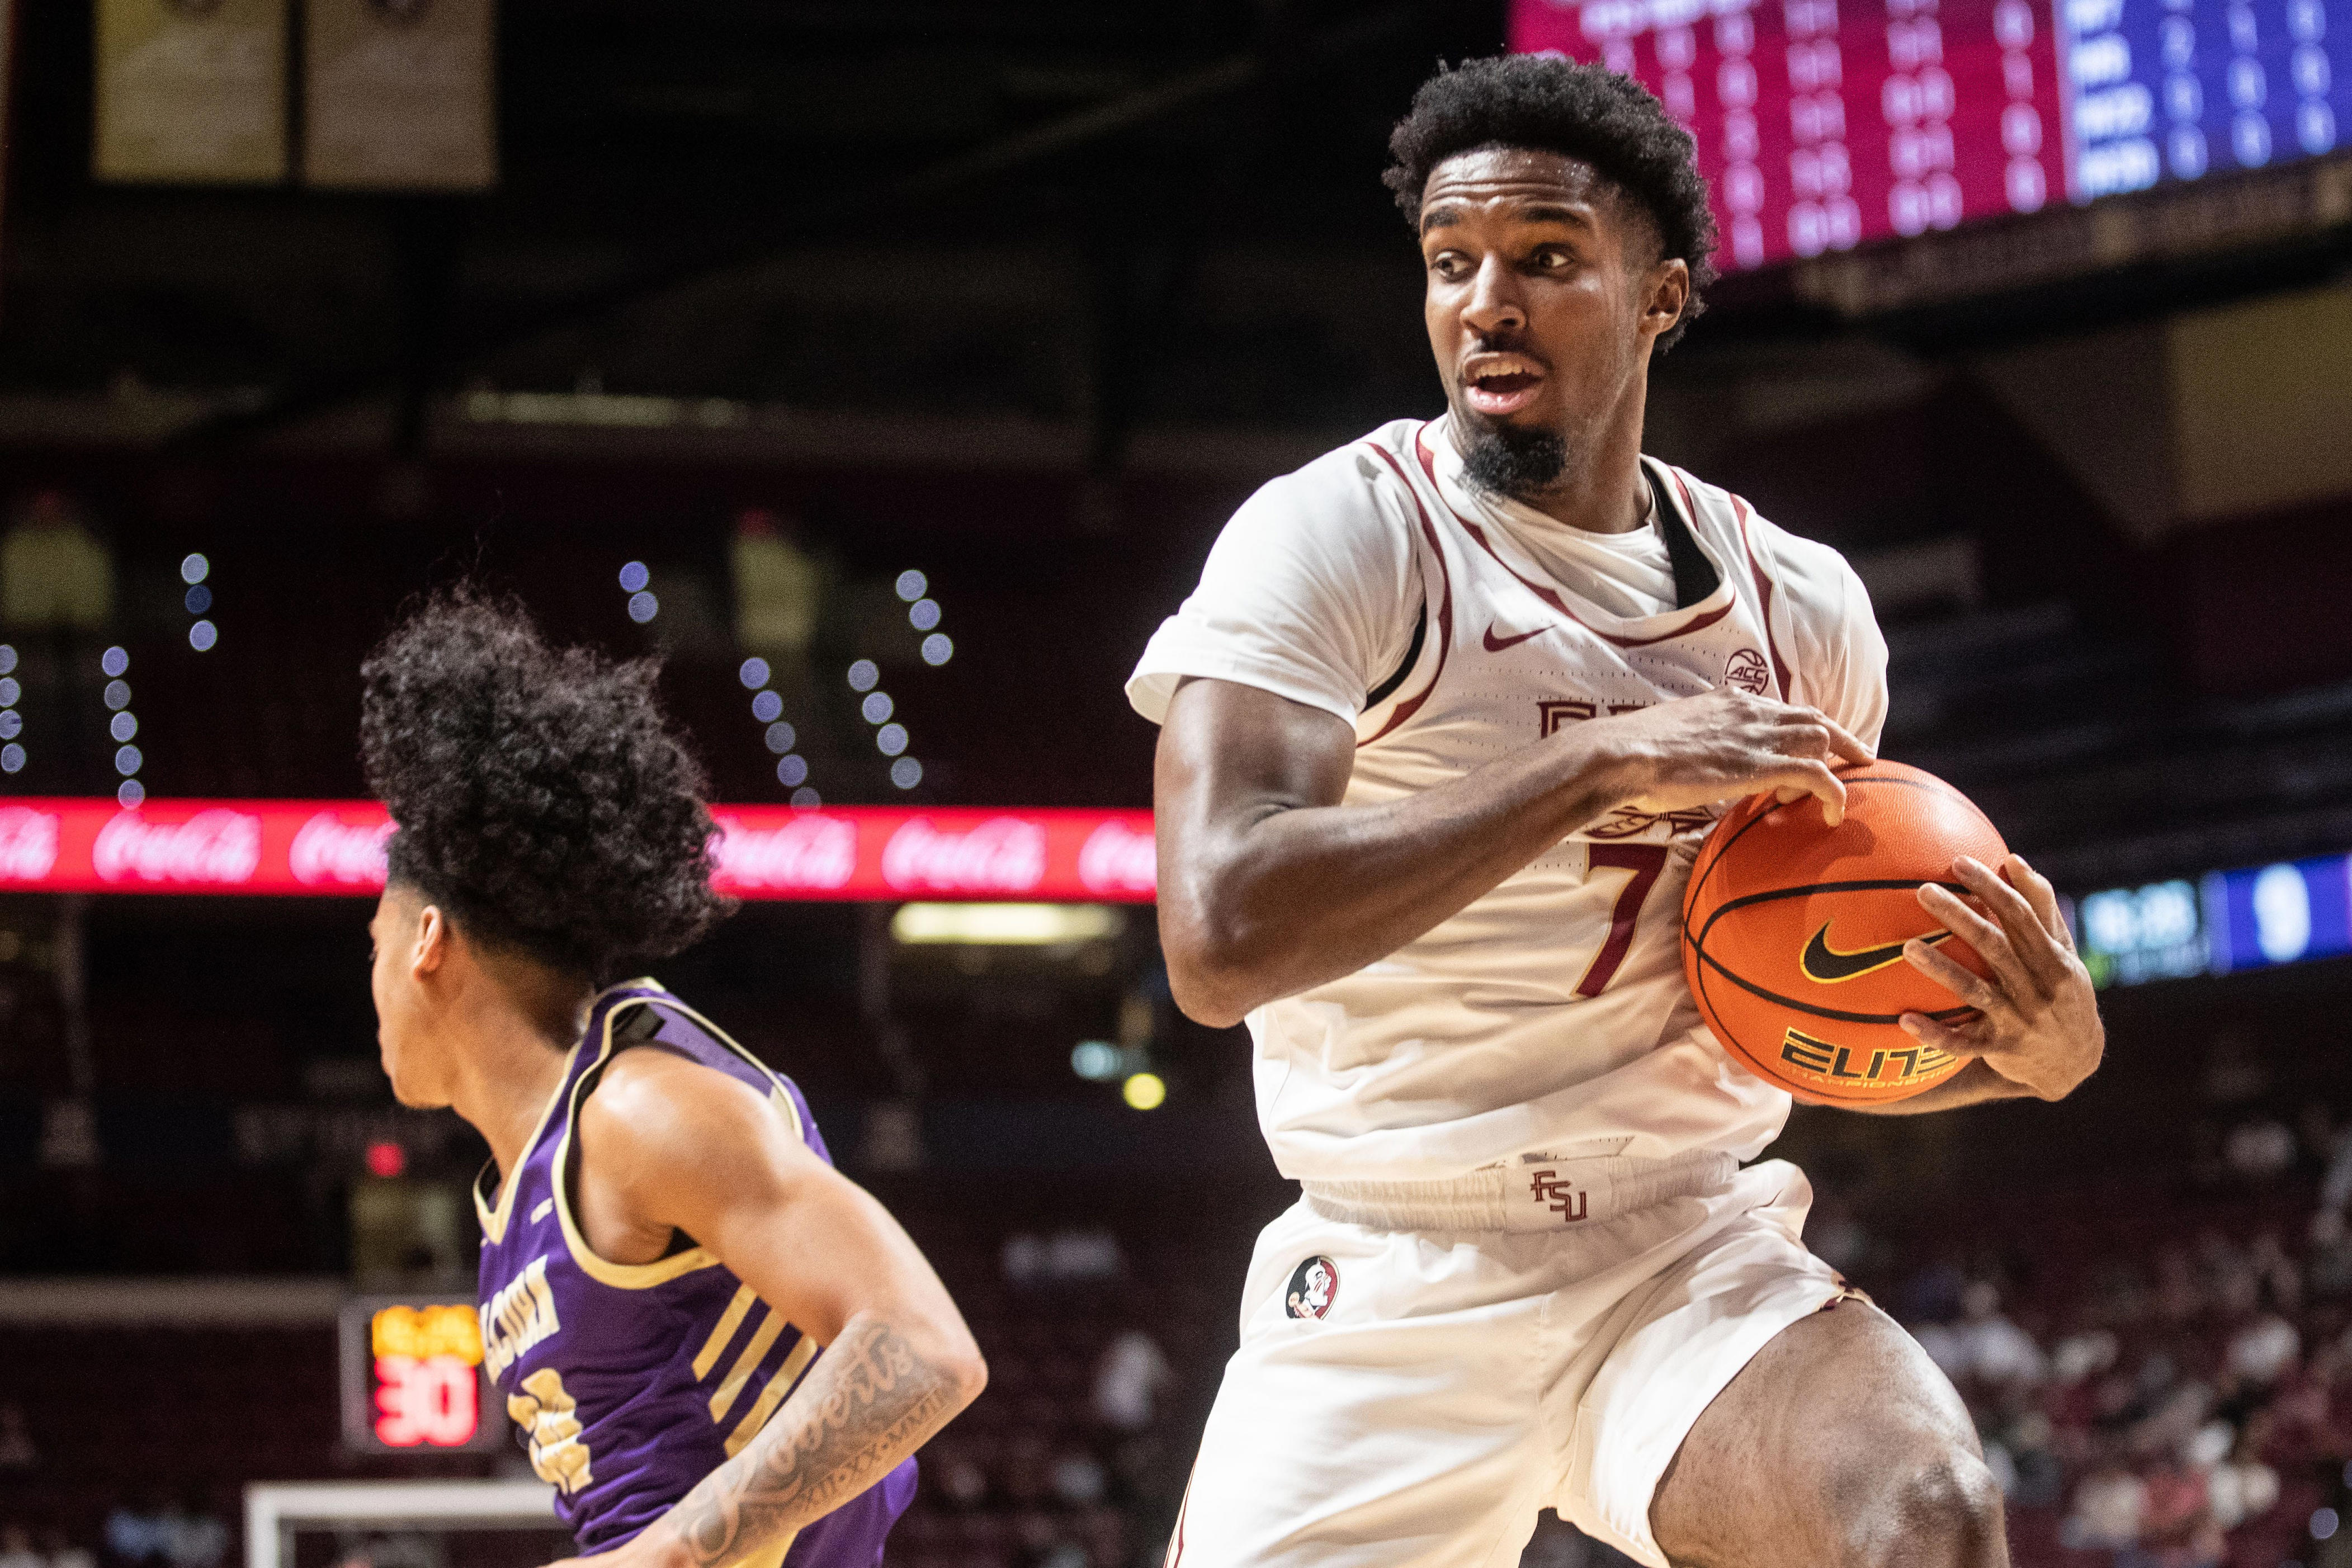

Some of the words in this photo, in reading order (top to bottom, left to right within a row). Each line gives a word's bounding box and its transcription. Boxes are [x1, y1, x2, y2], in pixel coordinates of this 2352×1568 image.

[1730, 666, 1765, 681] ACC
[1570, 842, 1669, 999] 7
[1780, 1026, 1958, 1081] ELITE
[1530, 1170, 1587, 1222] FSU
[374, 1354, 478, 1447] 30
